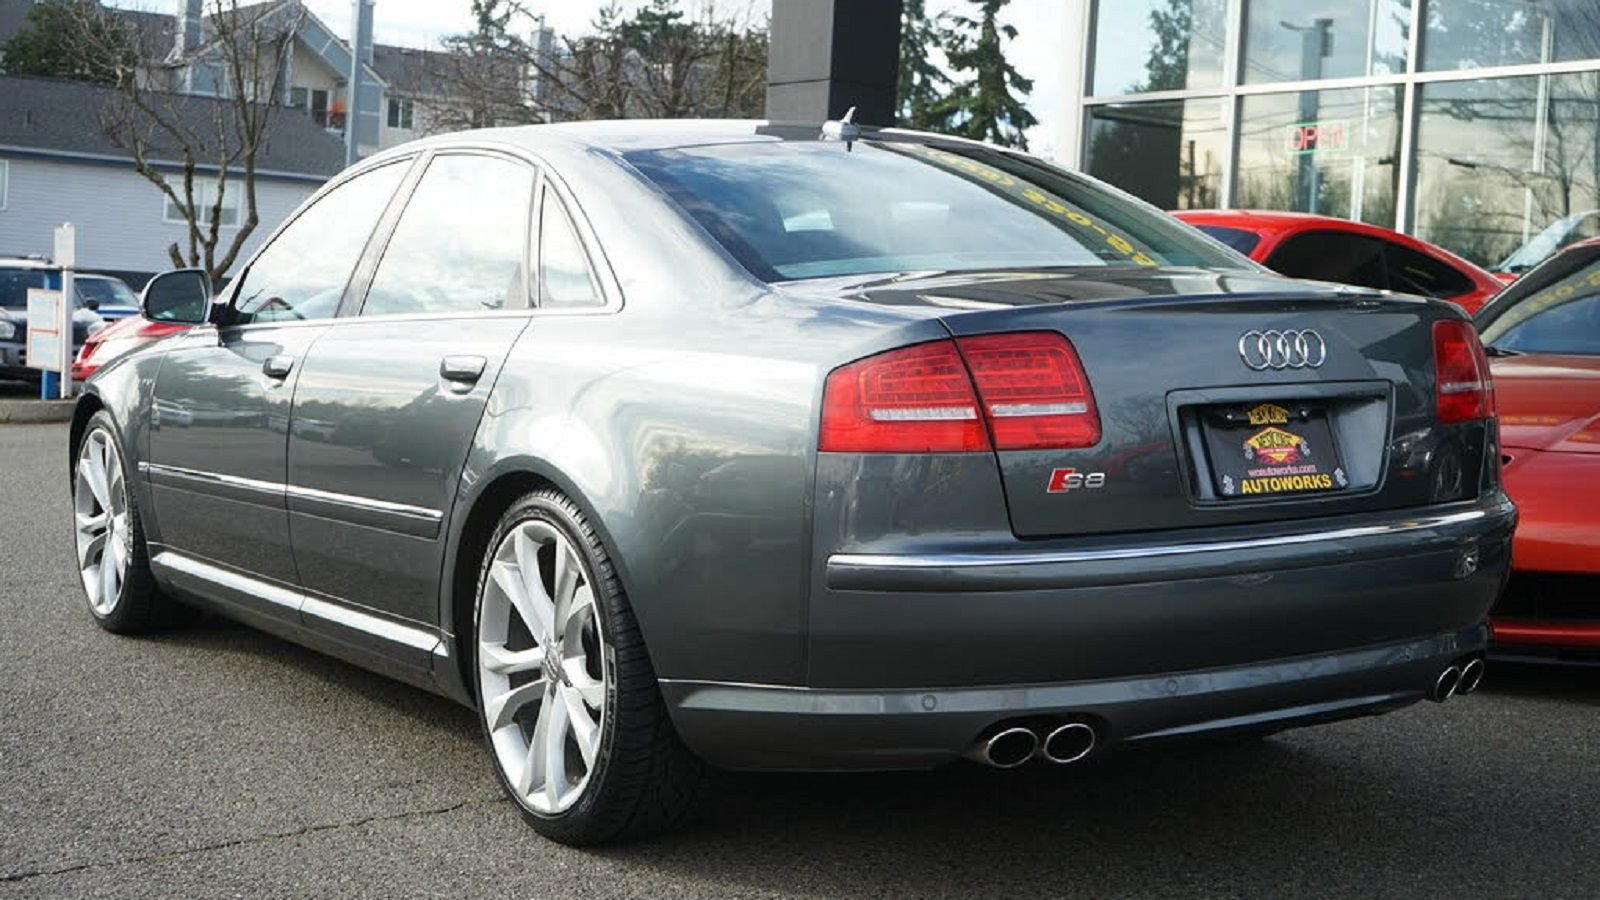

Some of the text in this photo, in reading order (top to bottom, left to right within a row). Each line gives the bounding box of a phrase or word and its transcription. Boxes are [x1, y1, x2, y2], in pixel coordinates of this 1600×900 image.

[1290, 124, 1344, 150] OPEN
[1059, 472, 1106, 489] S8
[1242, 474, 1332, 494] AUTOWORKS
